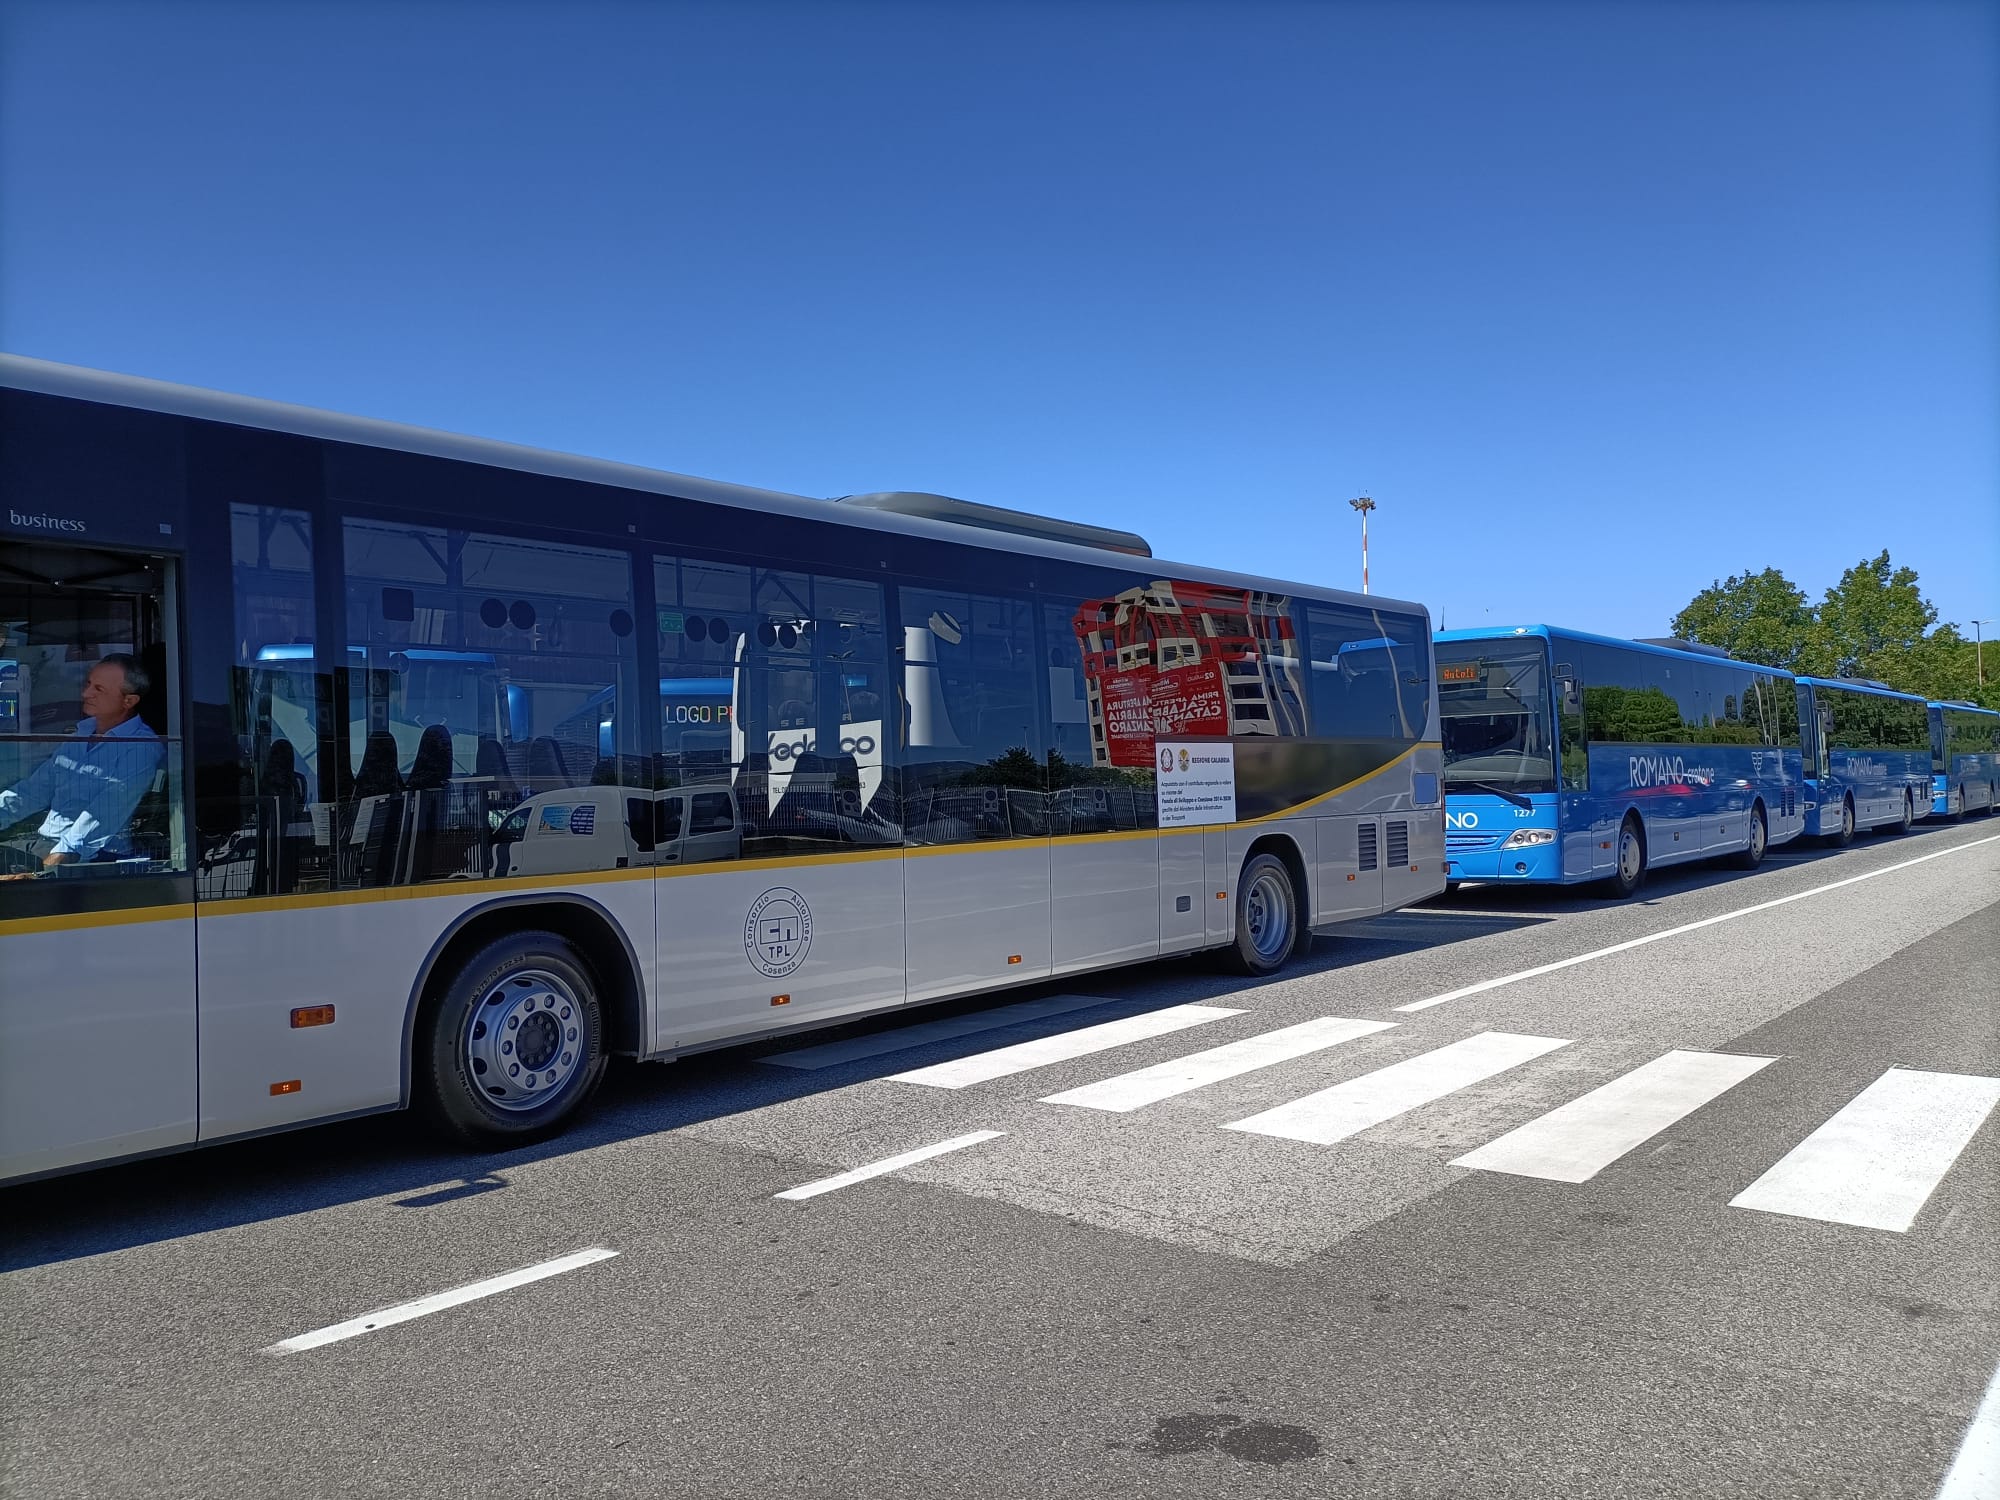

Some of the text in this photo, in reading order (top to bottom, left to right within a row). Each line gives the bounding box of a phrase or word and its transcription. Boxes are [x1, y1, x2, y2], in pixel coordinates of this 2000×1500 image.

[9, 509, 87, 532] business
[665, 705, 712, 724] LOGO
[1629, 756, 1684, 788] ROMANO
[1445, 812, 1479, 829] NO
[746, 895, 769, 948] Consorzio
[790, 894, 810, 942] Autolinee
[768, 944, 791, 959] TPL
[762, 960, 797, 975] Cosenza
